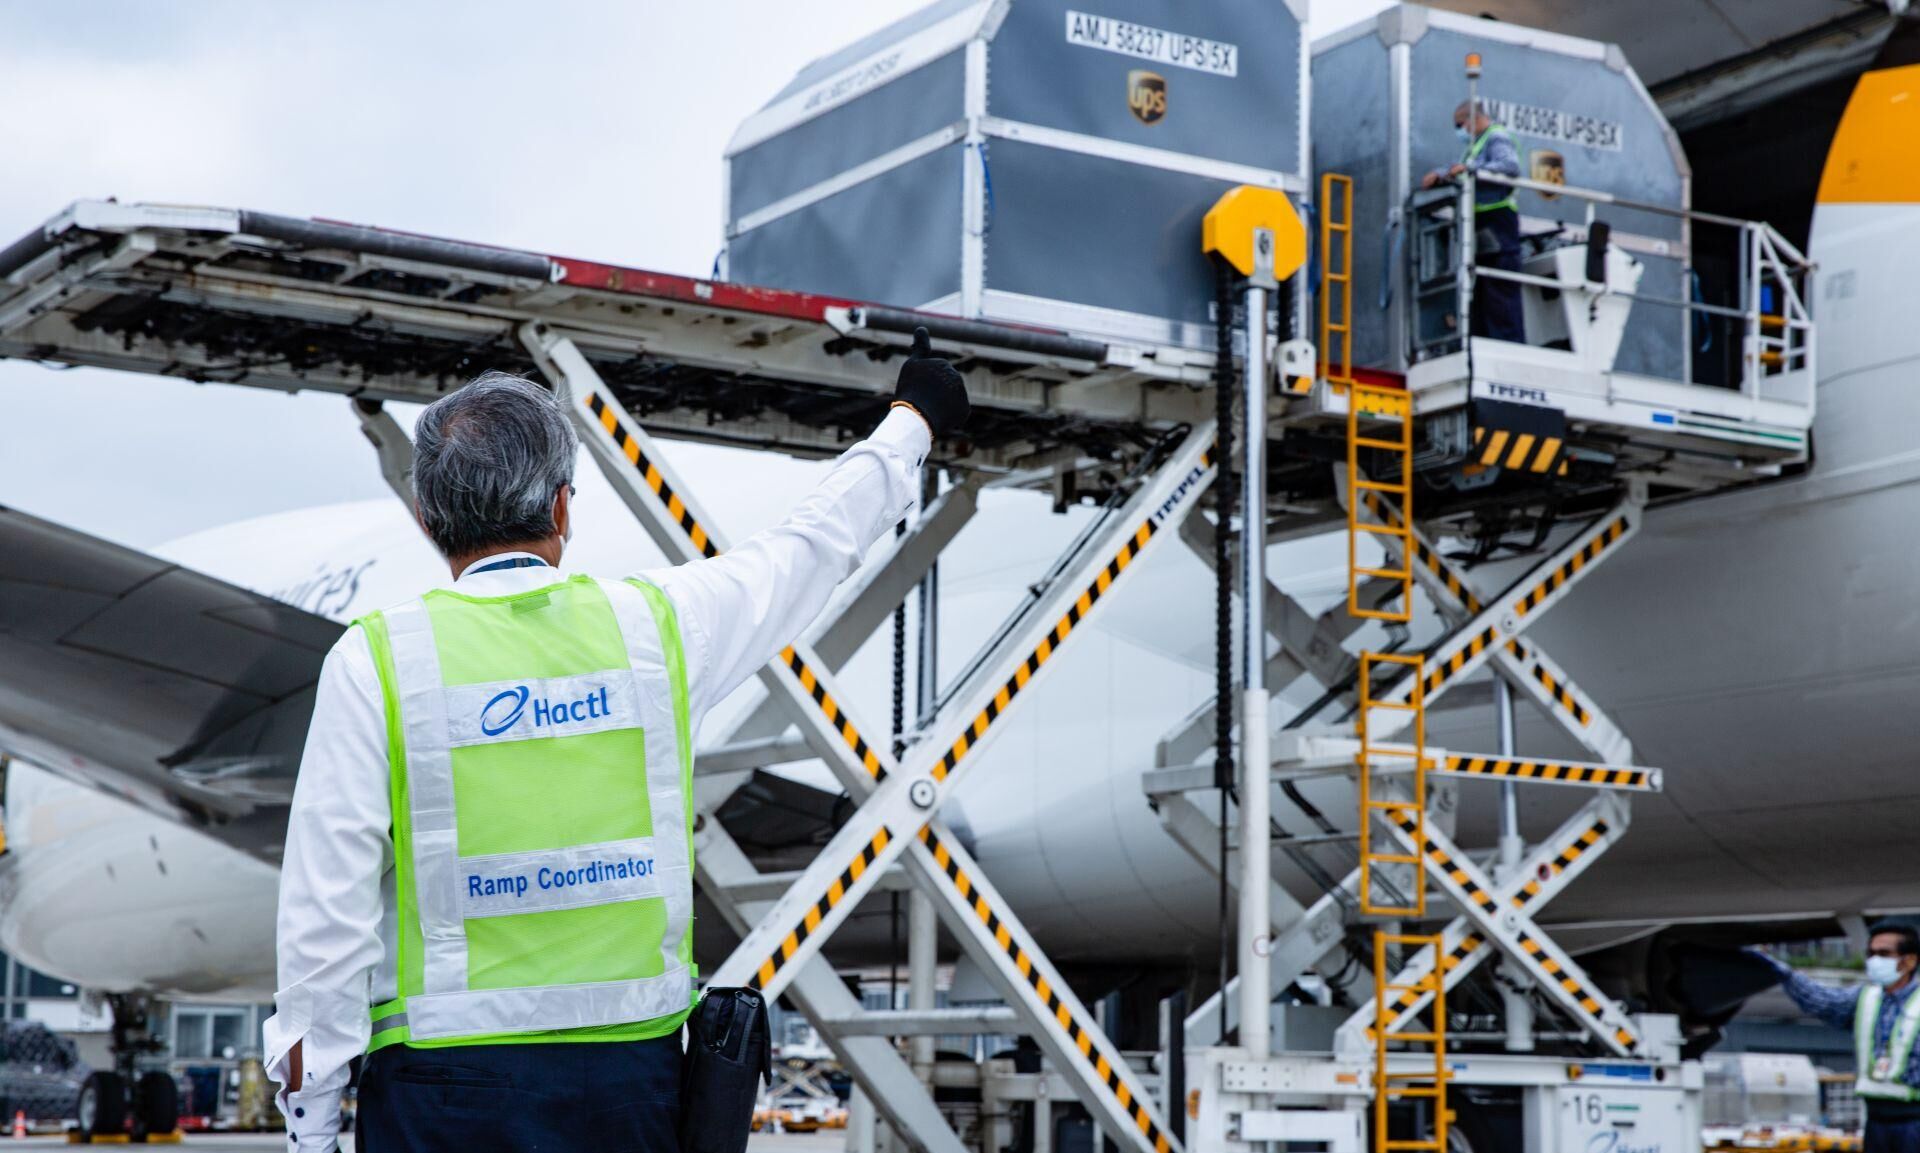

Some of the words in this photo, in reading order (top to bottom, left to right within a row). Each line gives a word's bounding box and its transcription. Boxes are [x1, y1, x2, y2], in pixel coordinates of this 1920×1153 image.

[1072, 13, 1110, 46] AMJ
[1116, 22, 1164, 58] 58237
[1169, 34, 1232, 73] UPS/5X
[1514, 104, 1560, 138] 60306
[533, 686, 611, 727] Hactl
[468, 874, 528, 898] Ramp
[537, 857, 655, 891] Coordinator
[1574, 1094, 1602, 1124] 16
